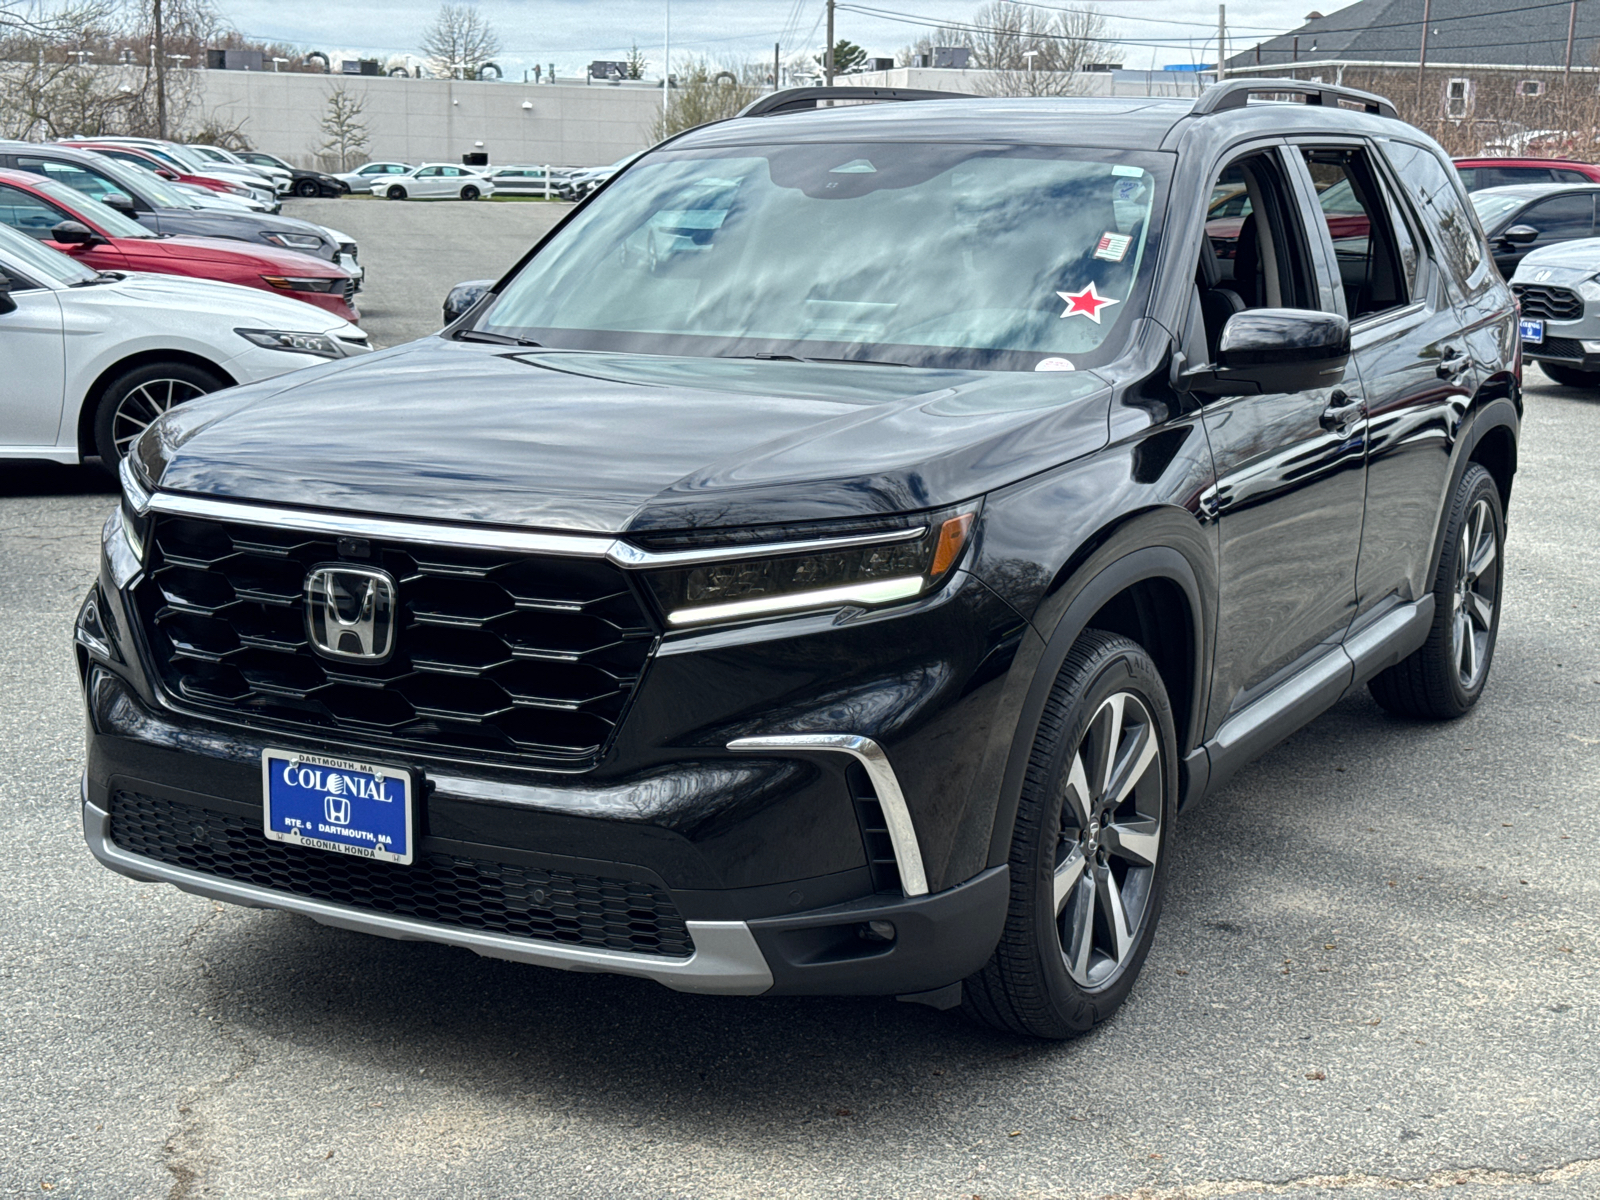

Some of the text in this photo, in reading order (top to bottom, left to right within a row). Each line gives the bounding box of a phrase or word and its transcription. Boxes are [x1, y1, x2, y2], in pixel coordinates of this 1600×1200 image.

[299, 754, 374, 773] DARTMOUTH, MA
[283, 766, 393, 803] COLONIAL
[284, 817, 392, 844] RTE. 6 DARTMOUTH, MA
[300, 837, 376, 858] COLONIAL HONDA
